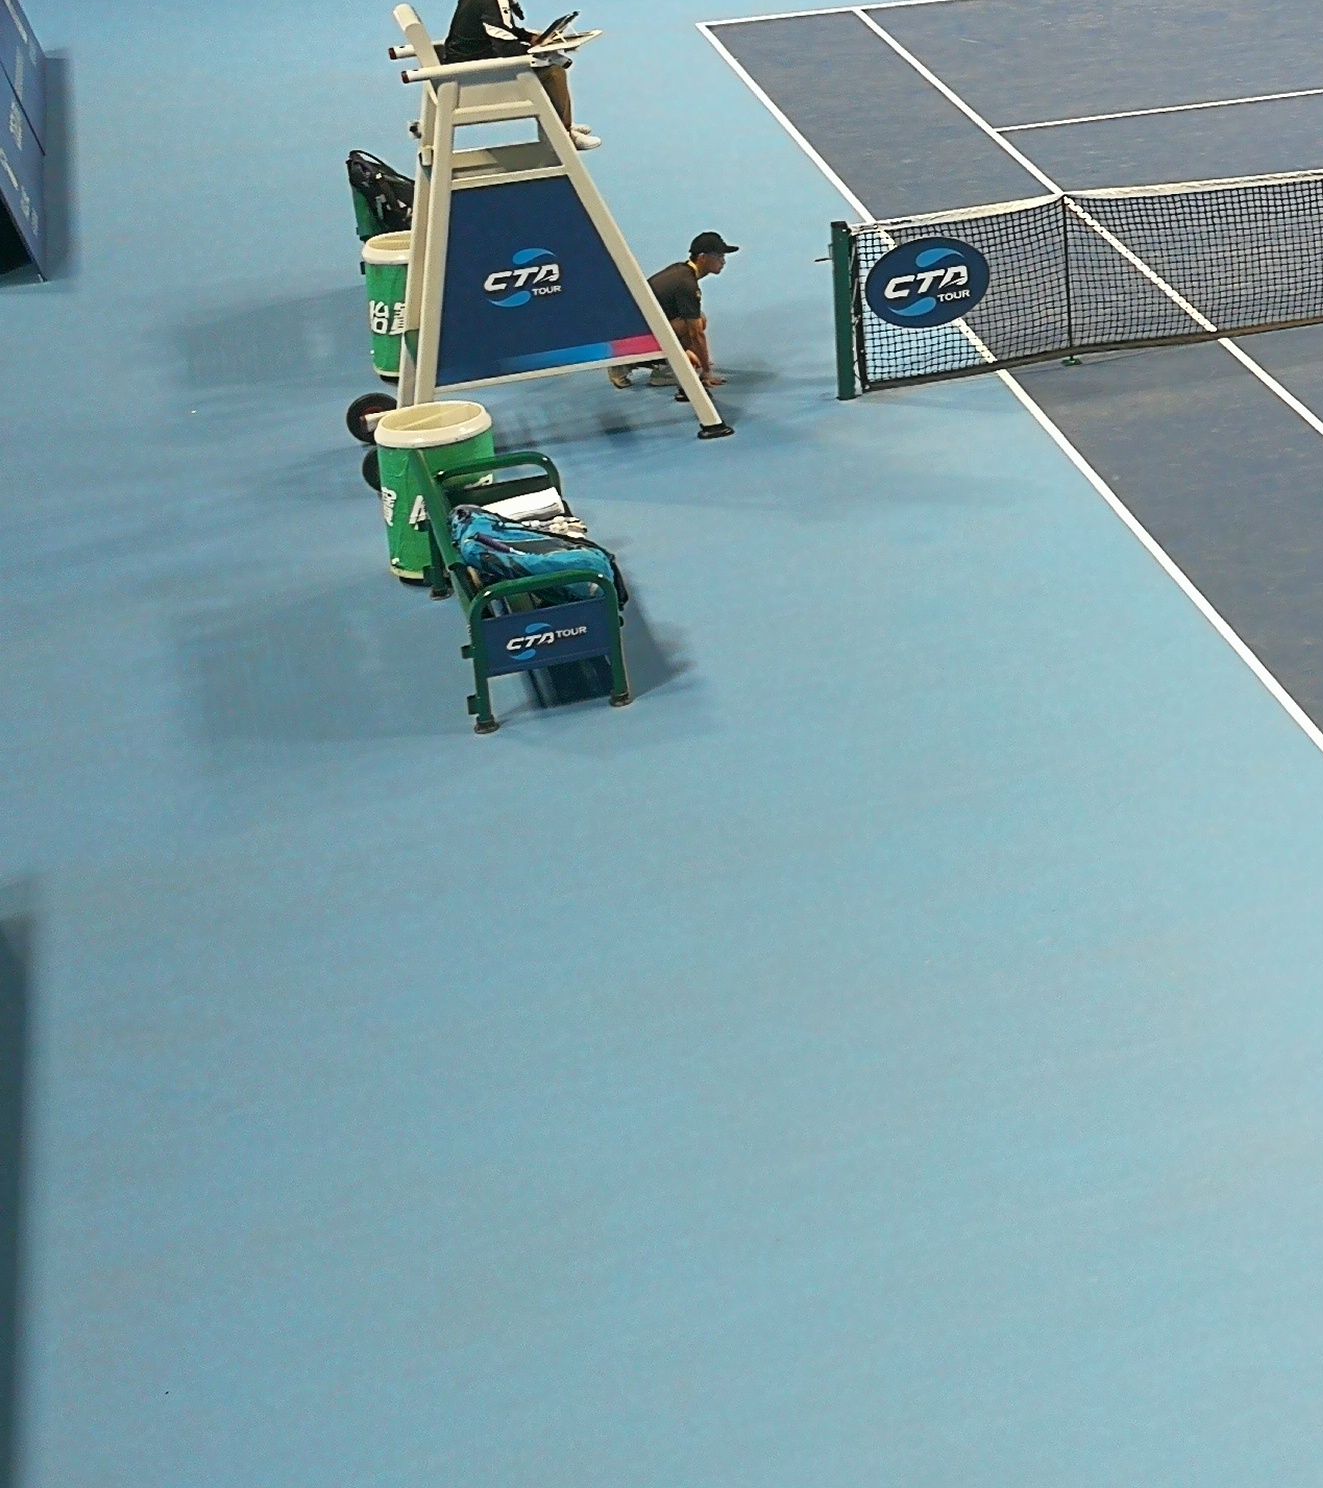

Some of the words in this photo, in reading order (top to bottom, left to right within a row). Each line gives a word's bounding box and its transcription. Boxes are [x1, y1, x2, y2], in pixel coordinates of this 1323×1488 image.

[483, 263, 560, 292] CTA
[532, 284, 562, 297] TOUR
[884, 265, 968, 299] CTA
[937, 289, 970, 303] TOUR
[506, 631, 554, 651] CTA
[555, 625, 588, 639] TOUR
